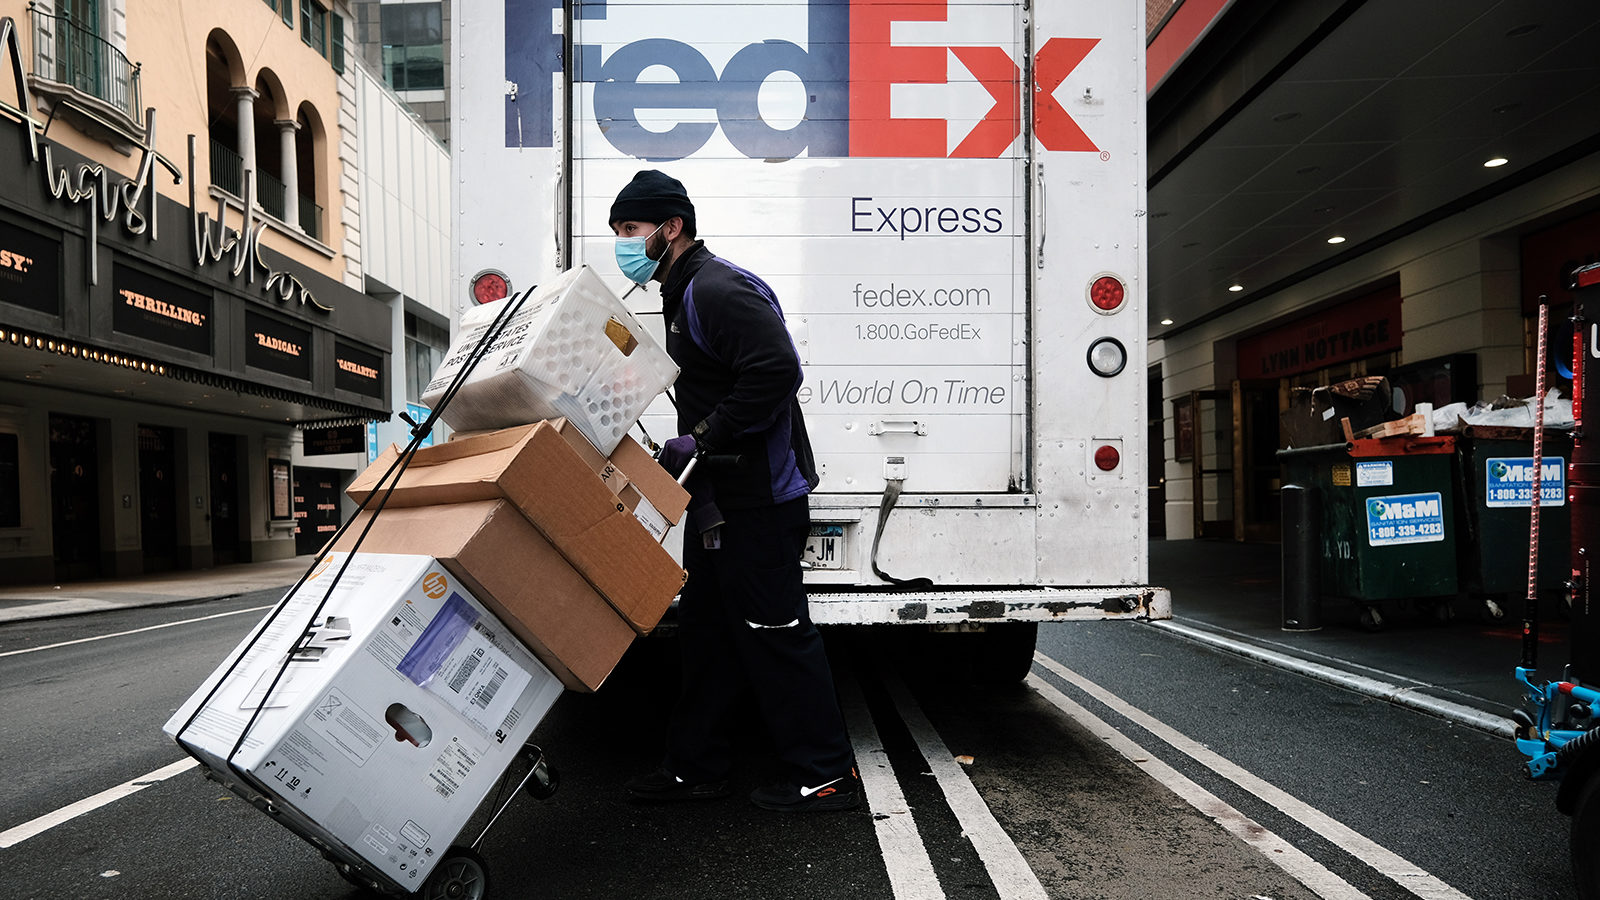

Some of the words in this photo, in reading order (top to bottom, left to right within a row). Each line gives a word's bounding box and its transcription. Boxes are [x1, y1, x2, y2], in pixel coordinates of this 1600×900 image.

[505, 0, 1102, 163] FedEx
[852, 197, 1003, 241] Express
[852, 283, 991, 307] fedex.com
[855, 323, 981, 340] 1.800.GoFedEx
[1261, 346, 1299, 375] LYNN
[1305, 318, 1390, 364] NOTTAGE
[820, 380, 894, 404] World
[901, 379, 938, 404] On
[944, 379, 1006, 404] Time
[1380, 499, 1439, 520] M&M
[1371, 519, 1408, 527] SANITATION
[1371, 523, 1441, 539] 1-800-339-4283
[424, 573, 447, 597] hp
